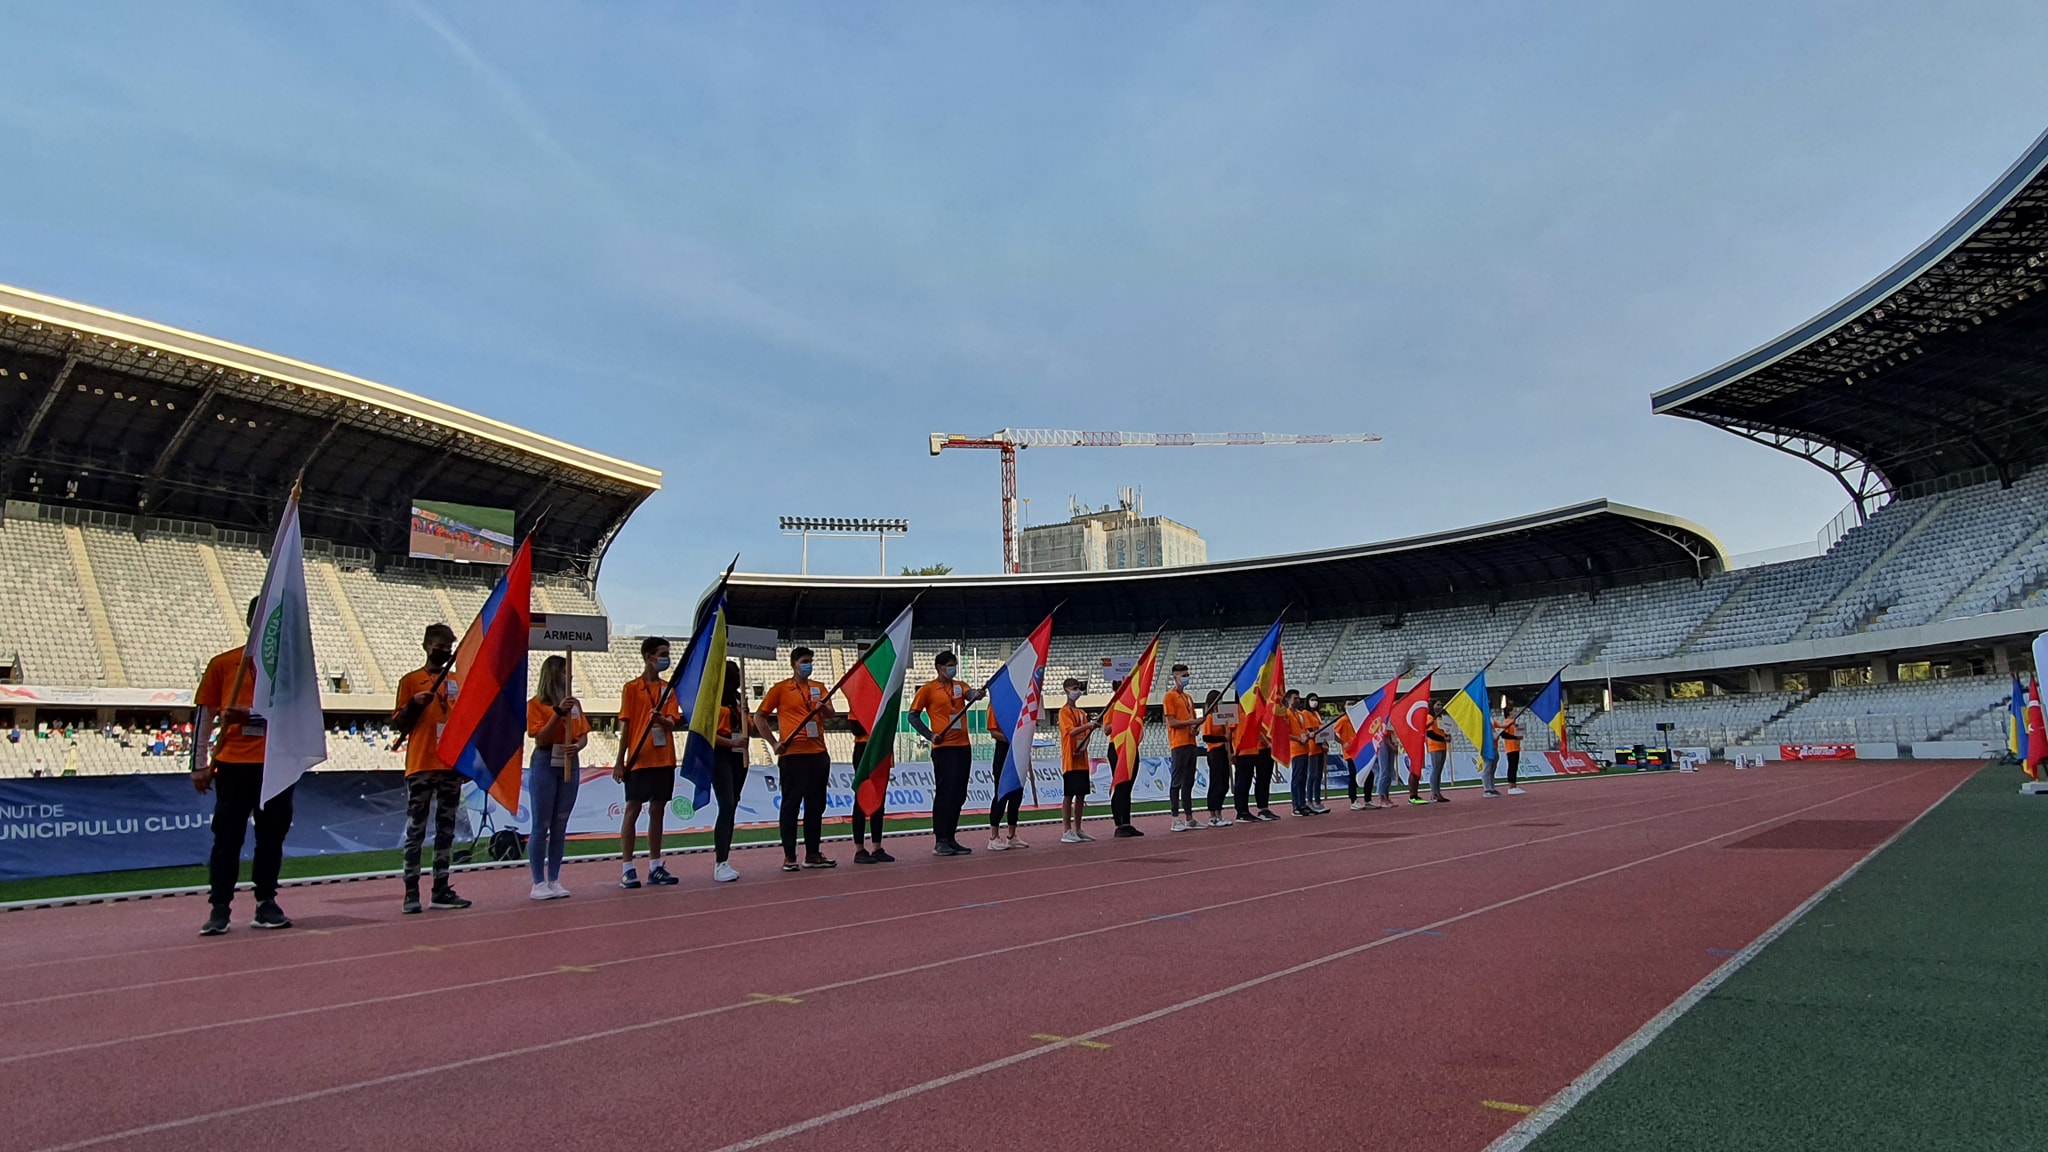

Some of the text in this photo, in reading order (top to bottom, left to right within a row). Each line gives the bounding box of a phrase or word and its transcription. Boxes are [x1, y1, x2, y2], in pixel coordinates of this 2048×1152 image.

[264, 618, 280, 665] ASSOCIA
[543, 630, 593, 642] ARMENIA
[886, 789, 924, 806] 2020
[1040, 788, 1064, 798] Septe
[39, 803, 65, 818] DE
